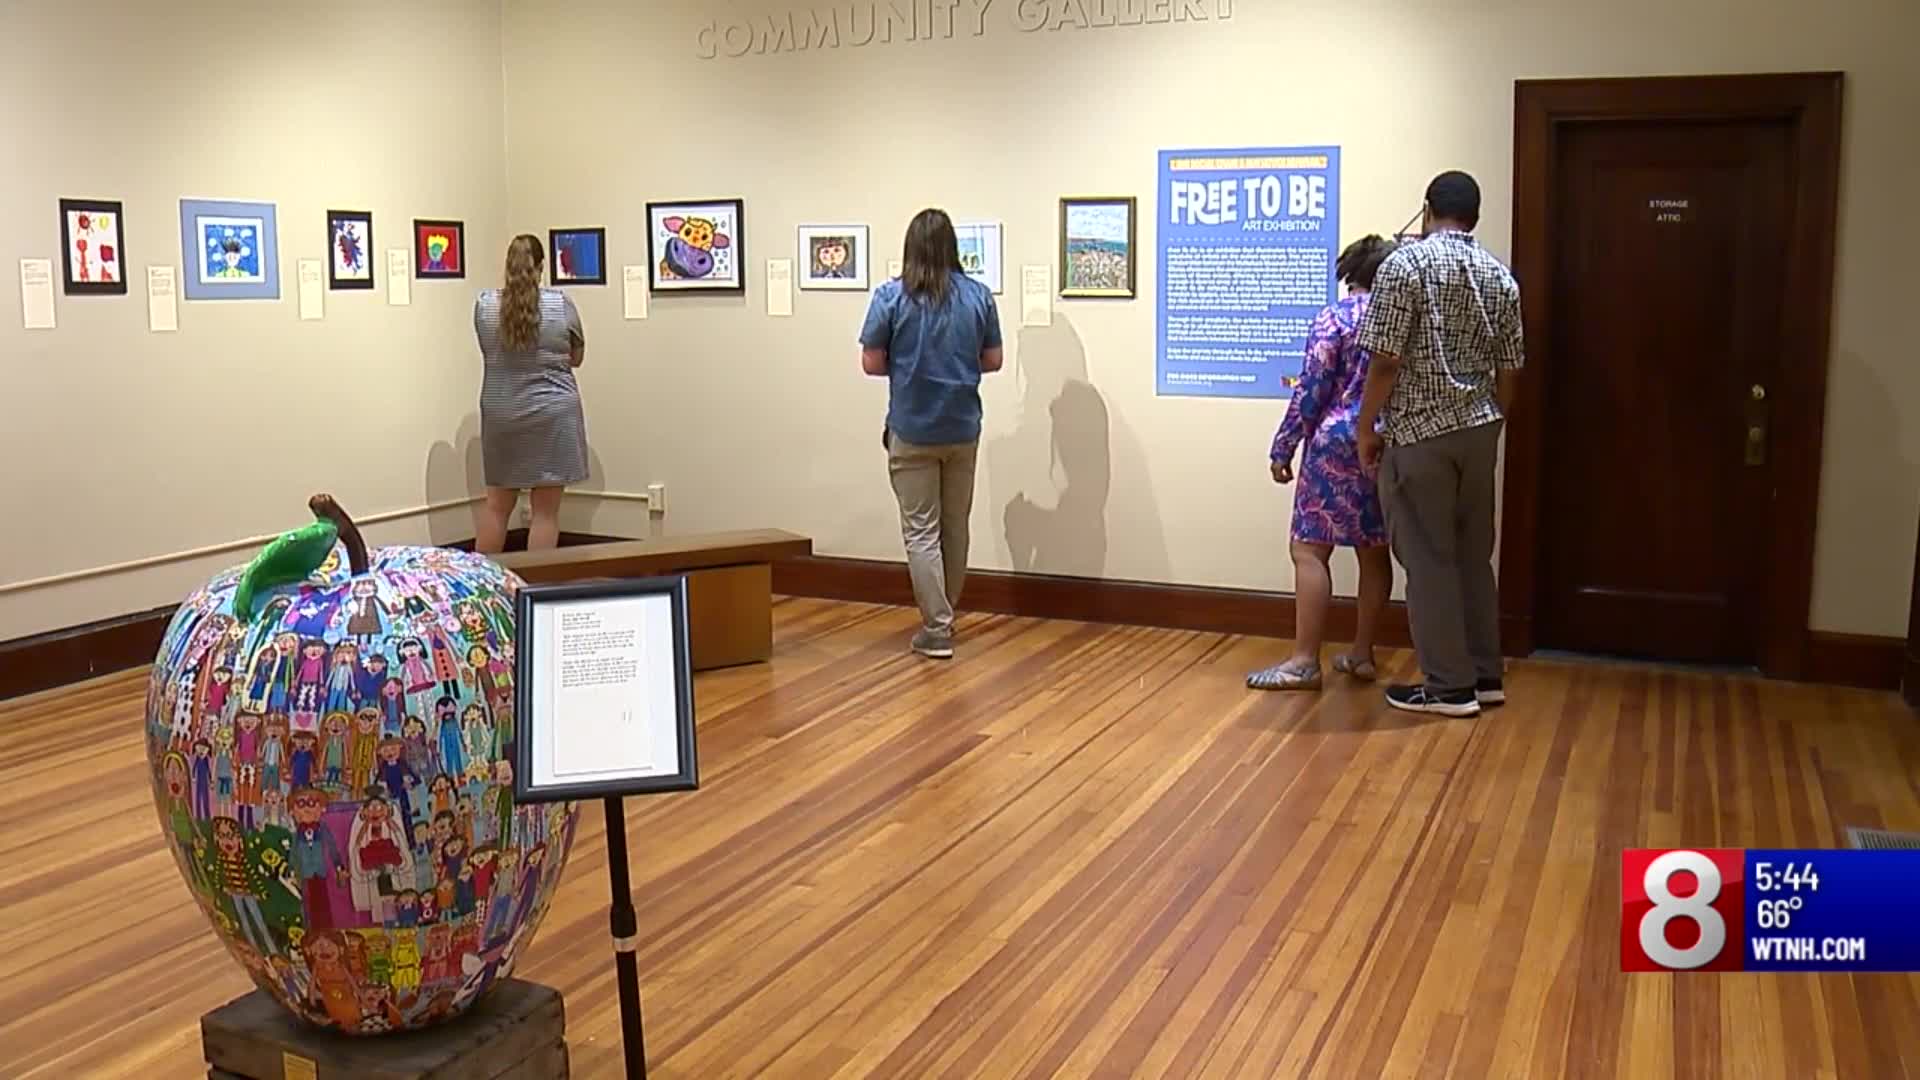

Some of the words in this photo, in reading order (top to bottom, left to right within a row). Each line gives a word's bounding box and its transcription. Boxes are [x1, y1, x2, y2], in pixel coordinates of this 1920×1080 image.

[695, 0, 993, 60] COMMUNITY
[1170, 180, 1237, 225] FREE
[1243, 175, 1282, 218] TO
[1288, 174, 1326, 219] BE
[1649, 200, 1688, 208] STORAGE
[1241, 222, 1264, 232] ART
[1264, 220, 1319, 231] EXHIBITION
